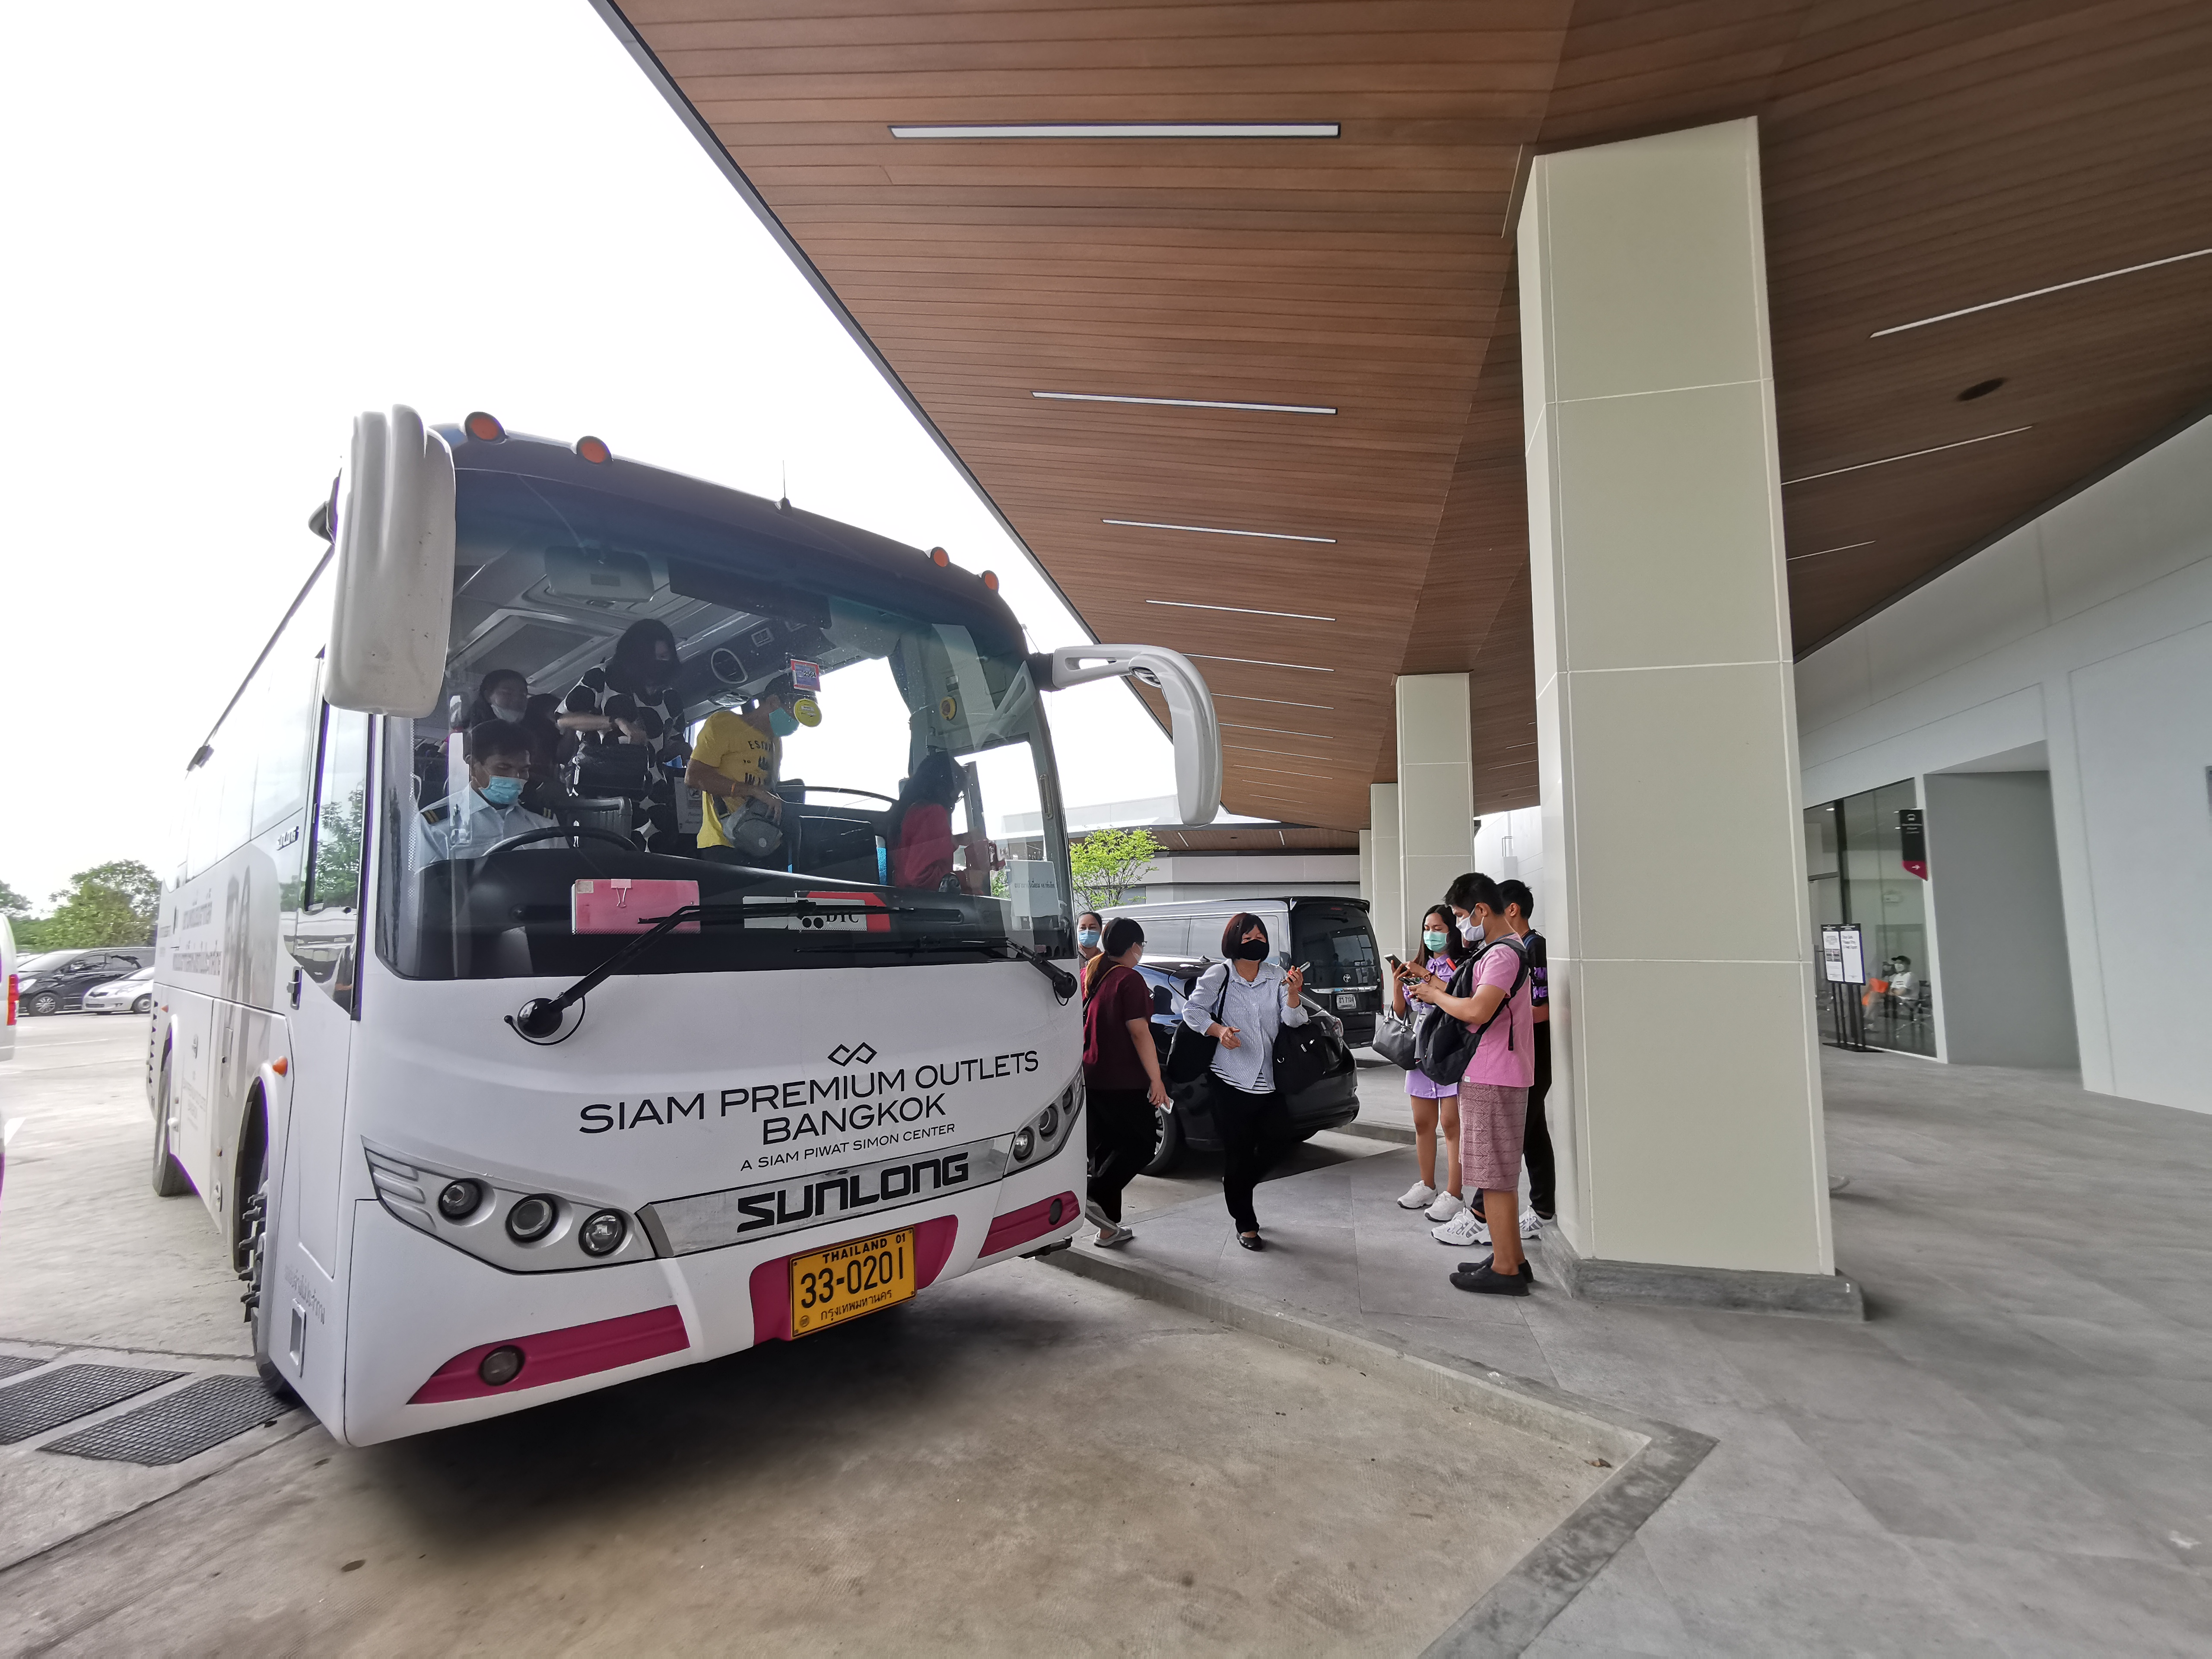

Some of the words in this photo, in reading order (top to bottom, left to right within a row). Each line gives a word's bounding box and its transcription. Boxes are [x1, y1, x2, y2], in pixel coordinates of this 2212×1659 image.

[578, 1093, 705, 1134] SIAM
[720, 1068, 905, 1117] PREMIUM
[915, 1050, 1039, 1089] OUTLETS
[763, 1093, 946, 1145] BANGKOK
[740, 1160, 753, 1172] A
[758, 1150, 799, 1168] SIAM
[804, 1142, 850, 1160] PIWAT
[853, 1133, 899, 1150] SIMON
[903, 1123, 955, 1141] CENTER
[736, 1151, 969, 1233] SUNLONG
[822, 1238, 887, 1264] THAILAND
[896, 1233, 906, 1244] 01
[801, 1246, 903, 1309] 33-0201
[820, 1289, 892, 1321] กรุงเทพมหานคร
